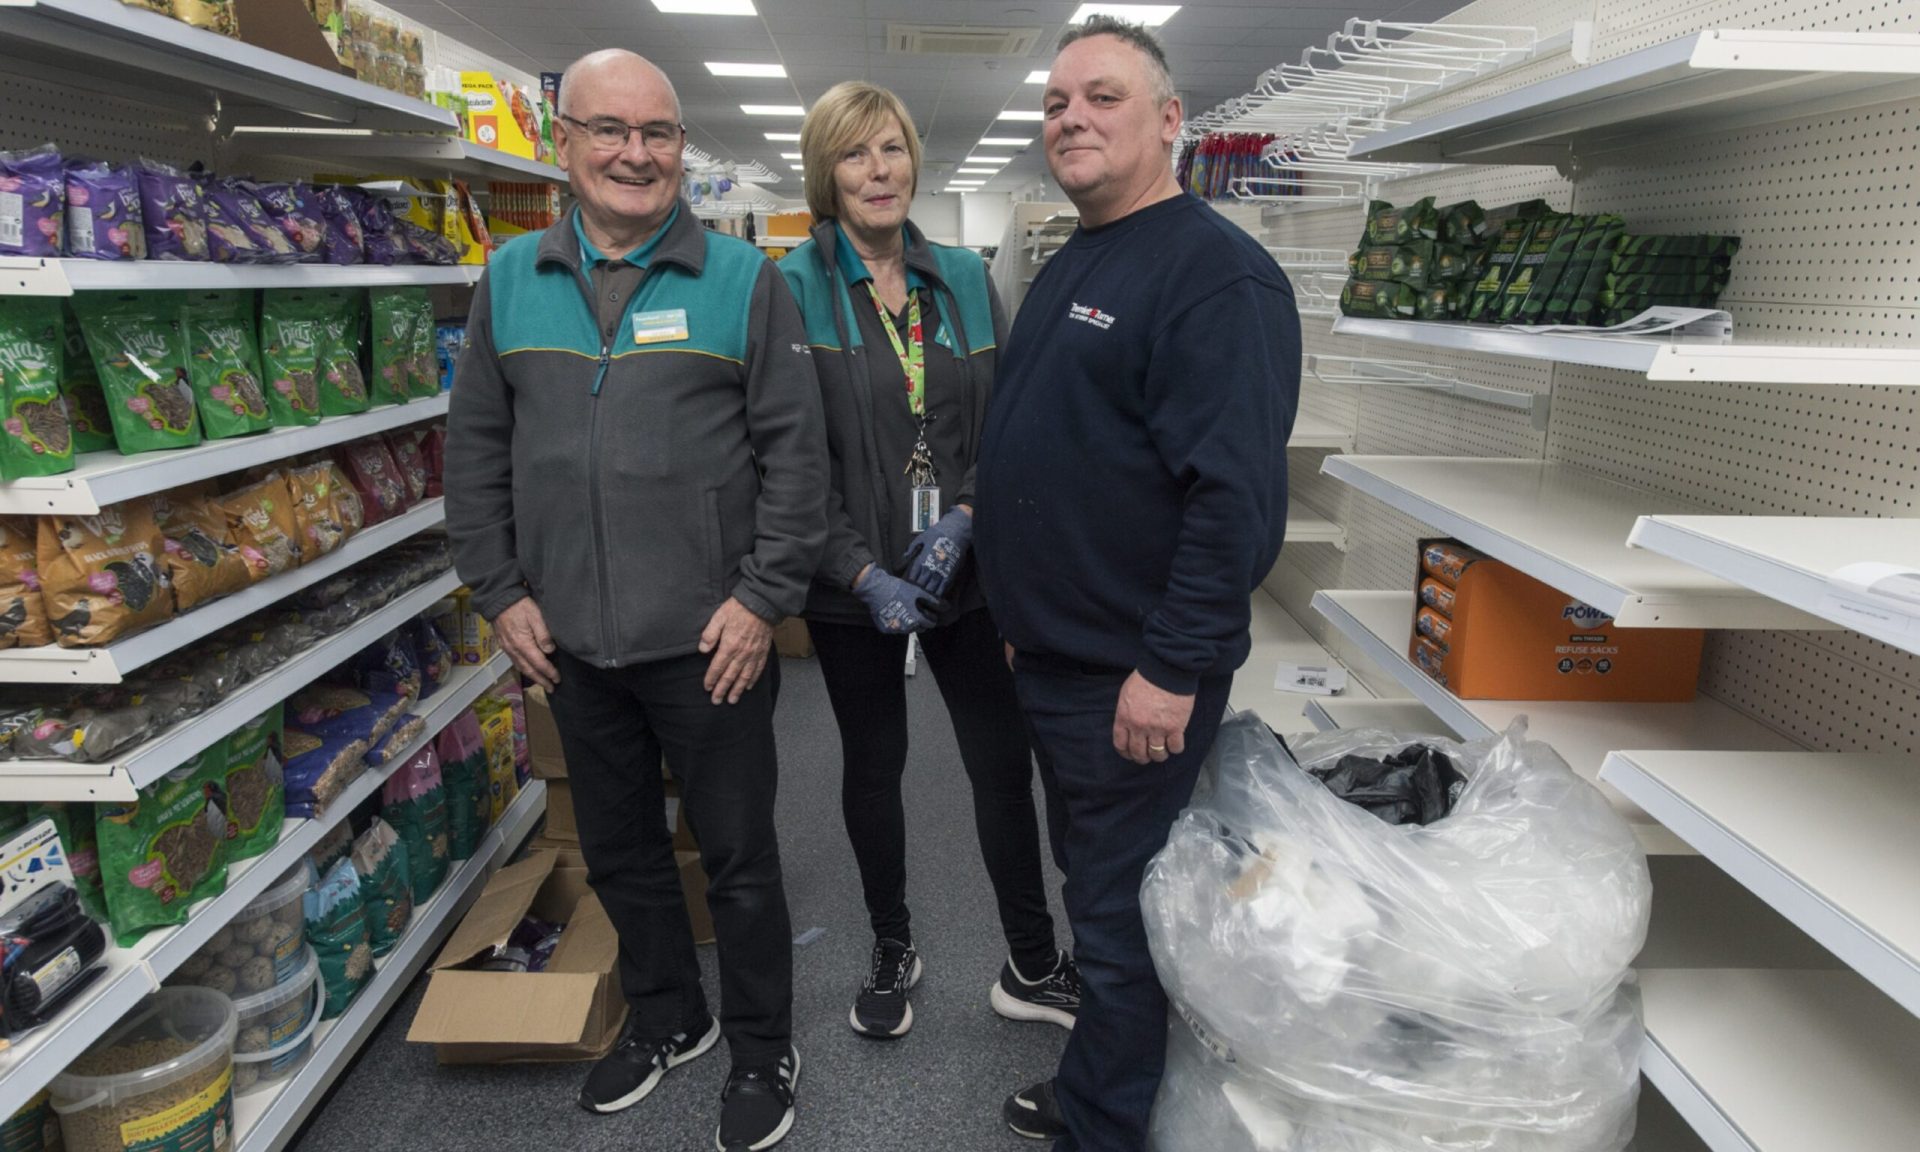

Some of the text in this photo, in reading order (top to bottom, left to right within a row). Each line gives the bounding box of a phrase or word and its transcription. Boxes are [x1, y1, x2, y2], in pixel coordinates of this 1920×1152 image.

[1555, 646, 1618, 654] REFUSE SACKS
[24, 828, 52, 847] DUNLOP
